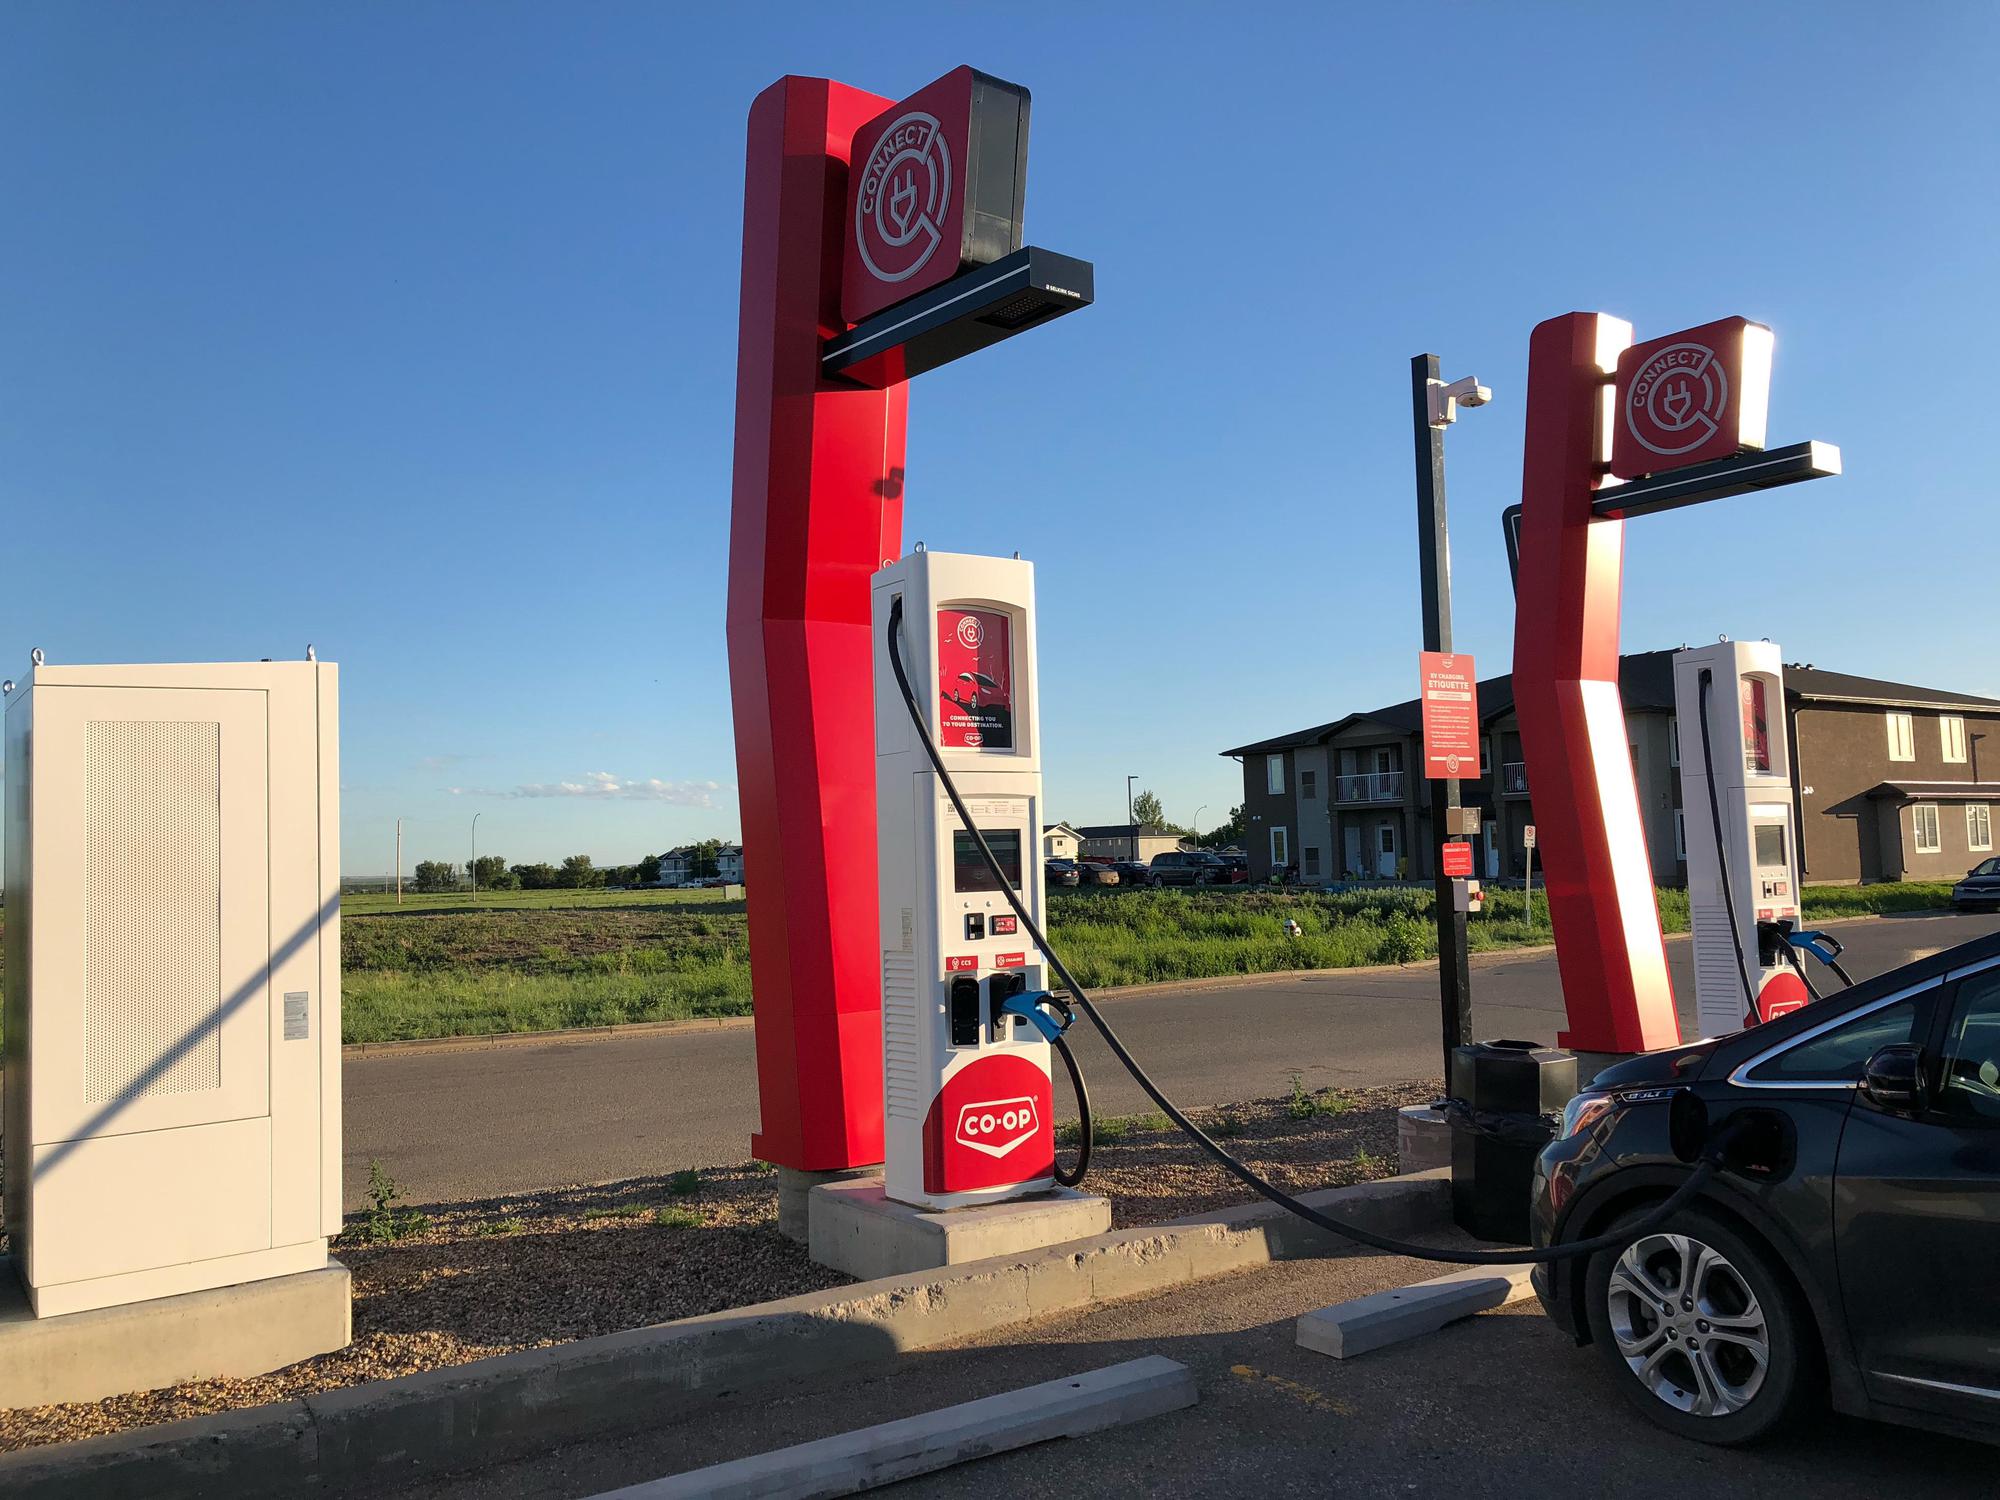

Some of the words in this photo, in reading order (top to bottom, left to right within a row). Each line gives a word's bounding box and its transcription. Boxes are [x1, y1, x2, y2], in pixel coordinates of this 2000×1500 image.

[862, 126, 930, 215] CONNECT
[1633, 351, 1702, 408] CONNECT
[1428, 680, 1469, 690] ETIQUETTE
